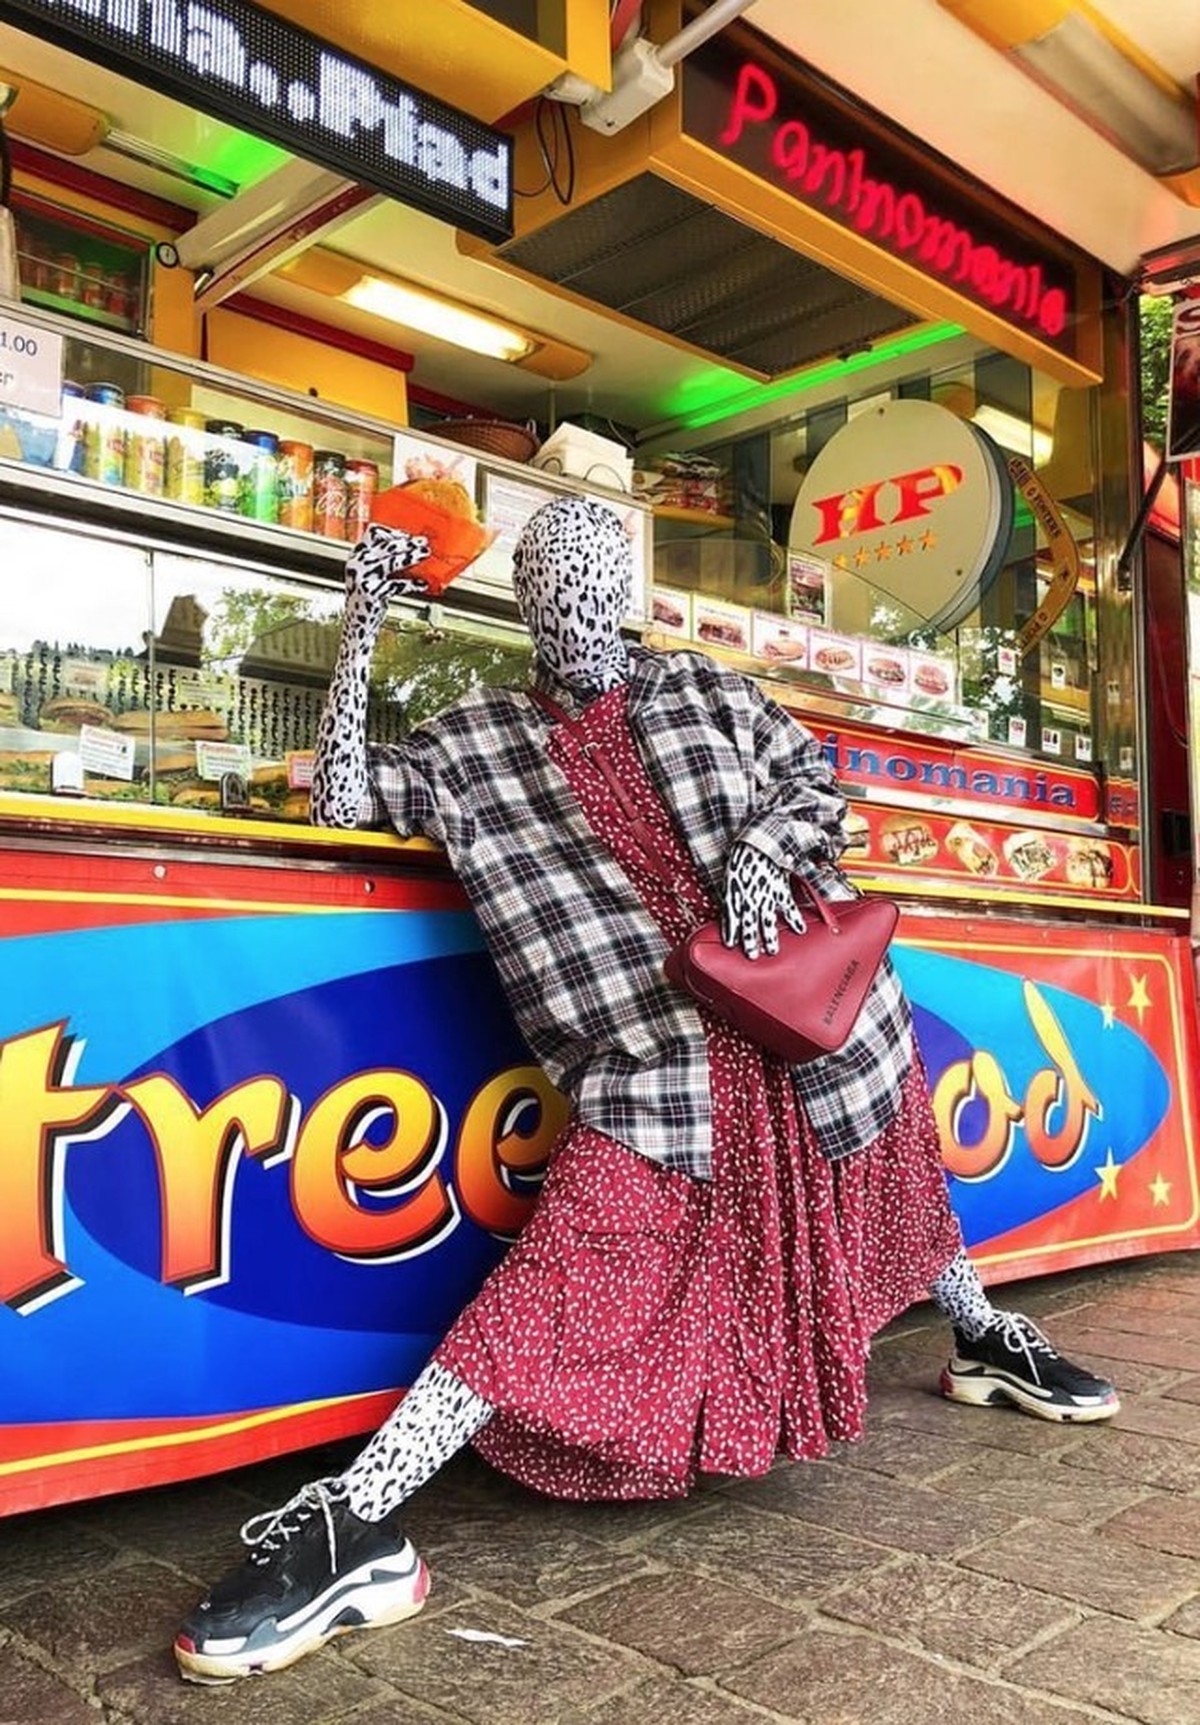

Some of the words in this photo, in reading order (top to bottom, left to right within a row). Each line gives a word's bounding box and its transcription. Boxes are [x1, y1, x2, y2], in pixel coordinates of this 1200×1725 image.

[721, 62, 1067, 337] Paninomania
[811, 464, 963, 546] HP
[822, 733, 1078, 809] inomania
[823, 958, 861, 1026] BALENCIAGA
[931, 978, 1103, 1184] od
